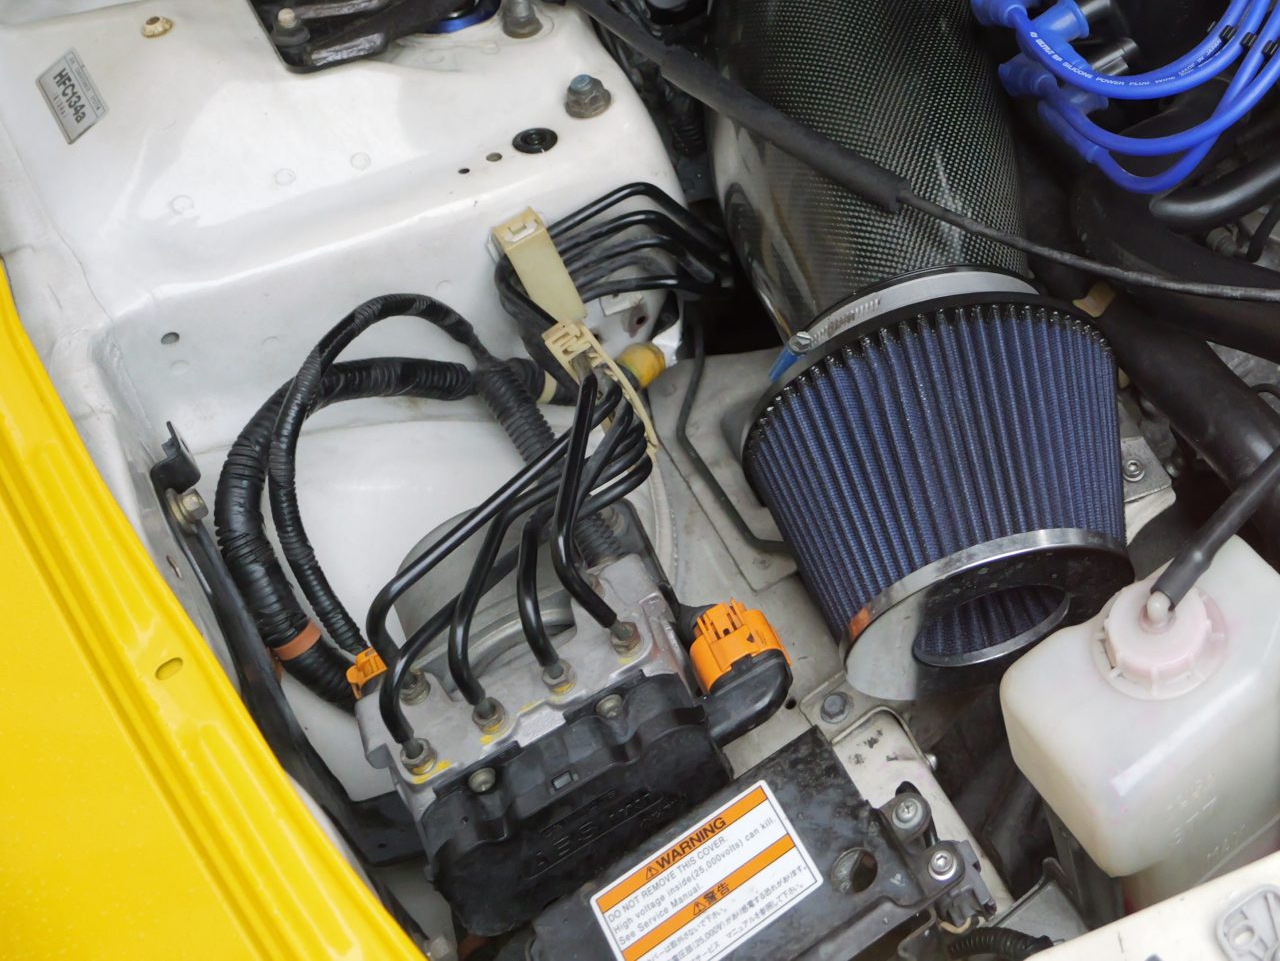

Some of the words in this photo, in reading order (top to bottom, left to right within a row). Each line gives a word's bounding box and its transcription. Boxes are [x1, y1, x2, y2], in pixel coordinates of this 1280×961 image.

[53, 68, 86, 124] HFC134a
[1096, 77, 1125, 86] POWER
[656, 816, 726, 869] WARNING
[606, 907, 623, 923] DO
[620, 894, 641, 912] NOT
[639, 869, 677, 899] REMOVE
[676, 855, 697, 873] THIS
[612, 914, 634, 935] High
[633, 892, 666, 919] voltage
[743, 827, 761, 842] can
[701, 879, 732, 906] 警告
[617, 927, 637, 945] See
[636, 904, 669, 932] Service
